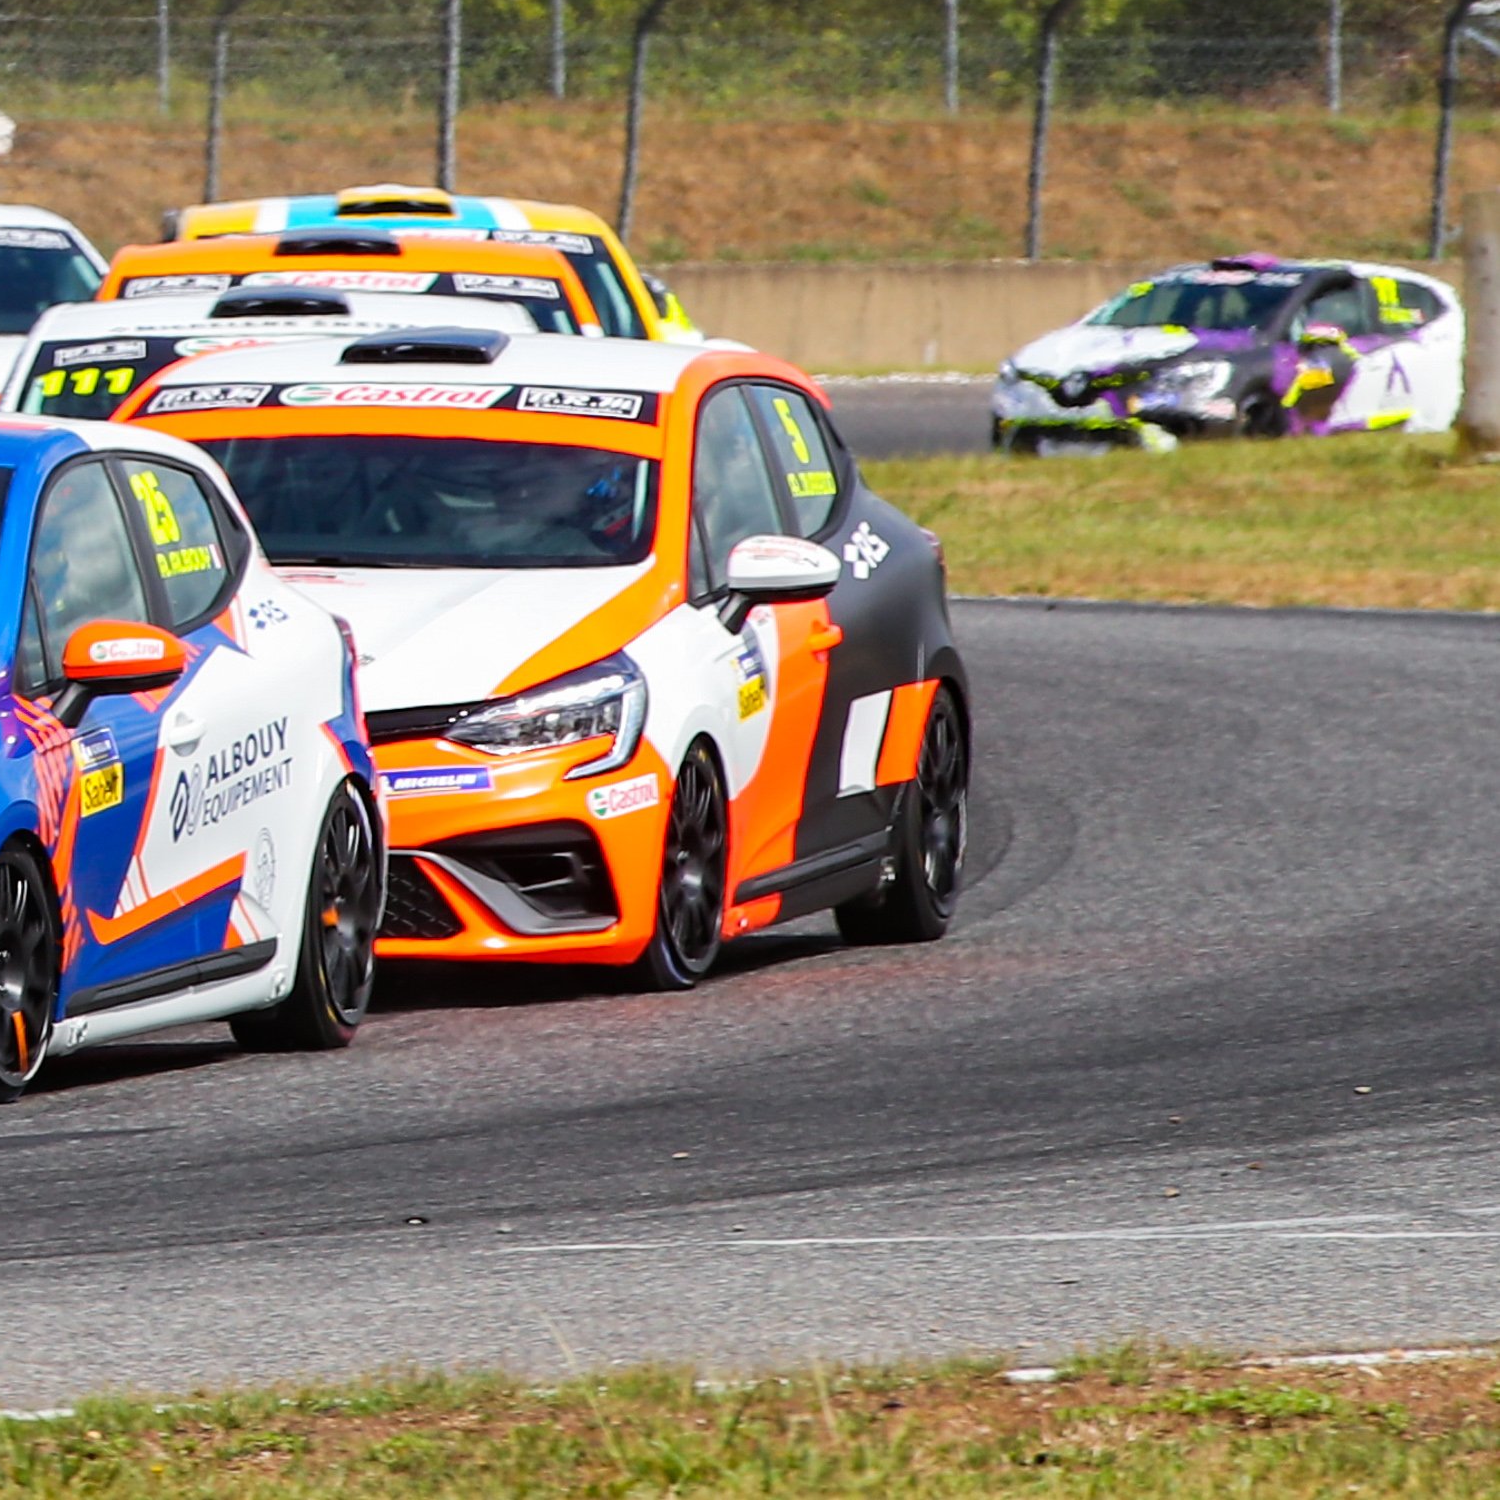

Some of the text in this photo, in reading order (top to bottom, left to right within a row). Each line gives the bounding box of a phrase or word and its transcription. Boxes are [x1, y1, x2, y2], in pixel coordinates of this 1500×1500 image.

[39, 367, 135, 396] 111
[334, 385, 496, 405] Castrol
[130, 470, 181, 546] 25
[205, 716, 288, 789] ALBOUY
[202, 757, 293, 827] EQUIPEMENT
[394, 773, 478, 790] MICHELIN
